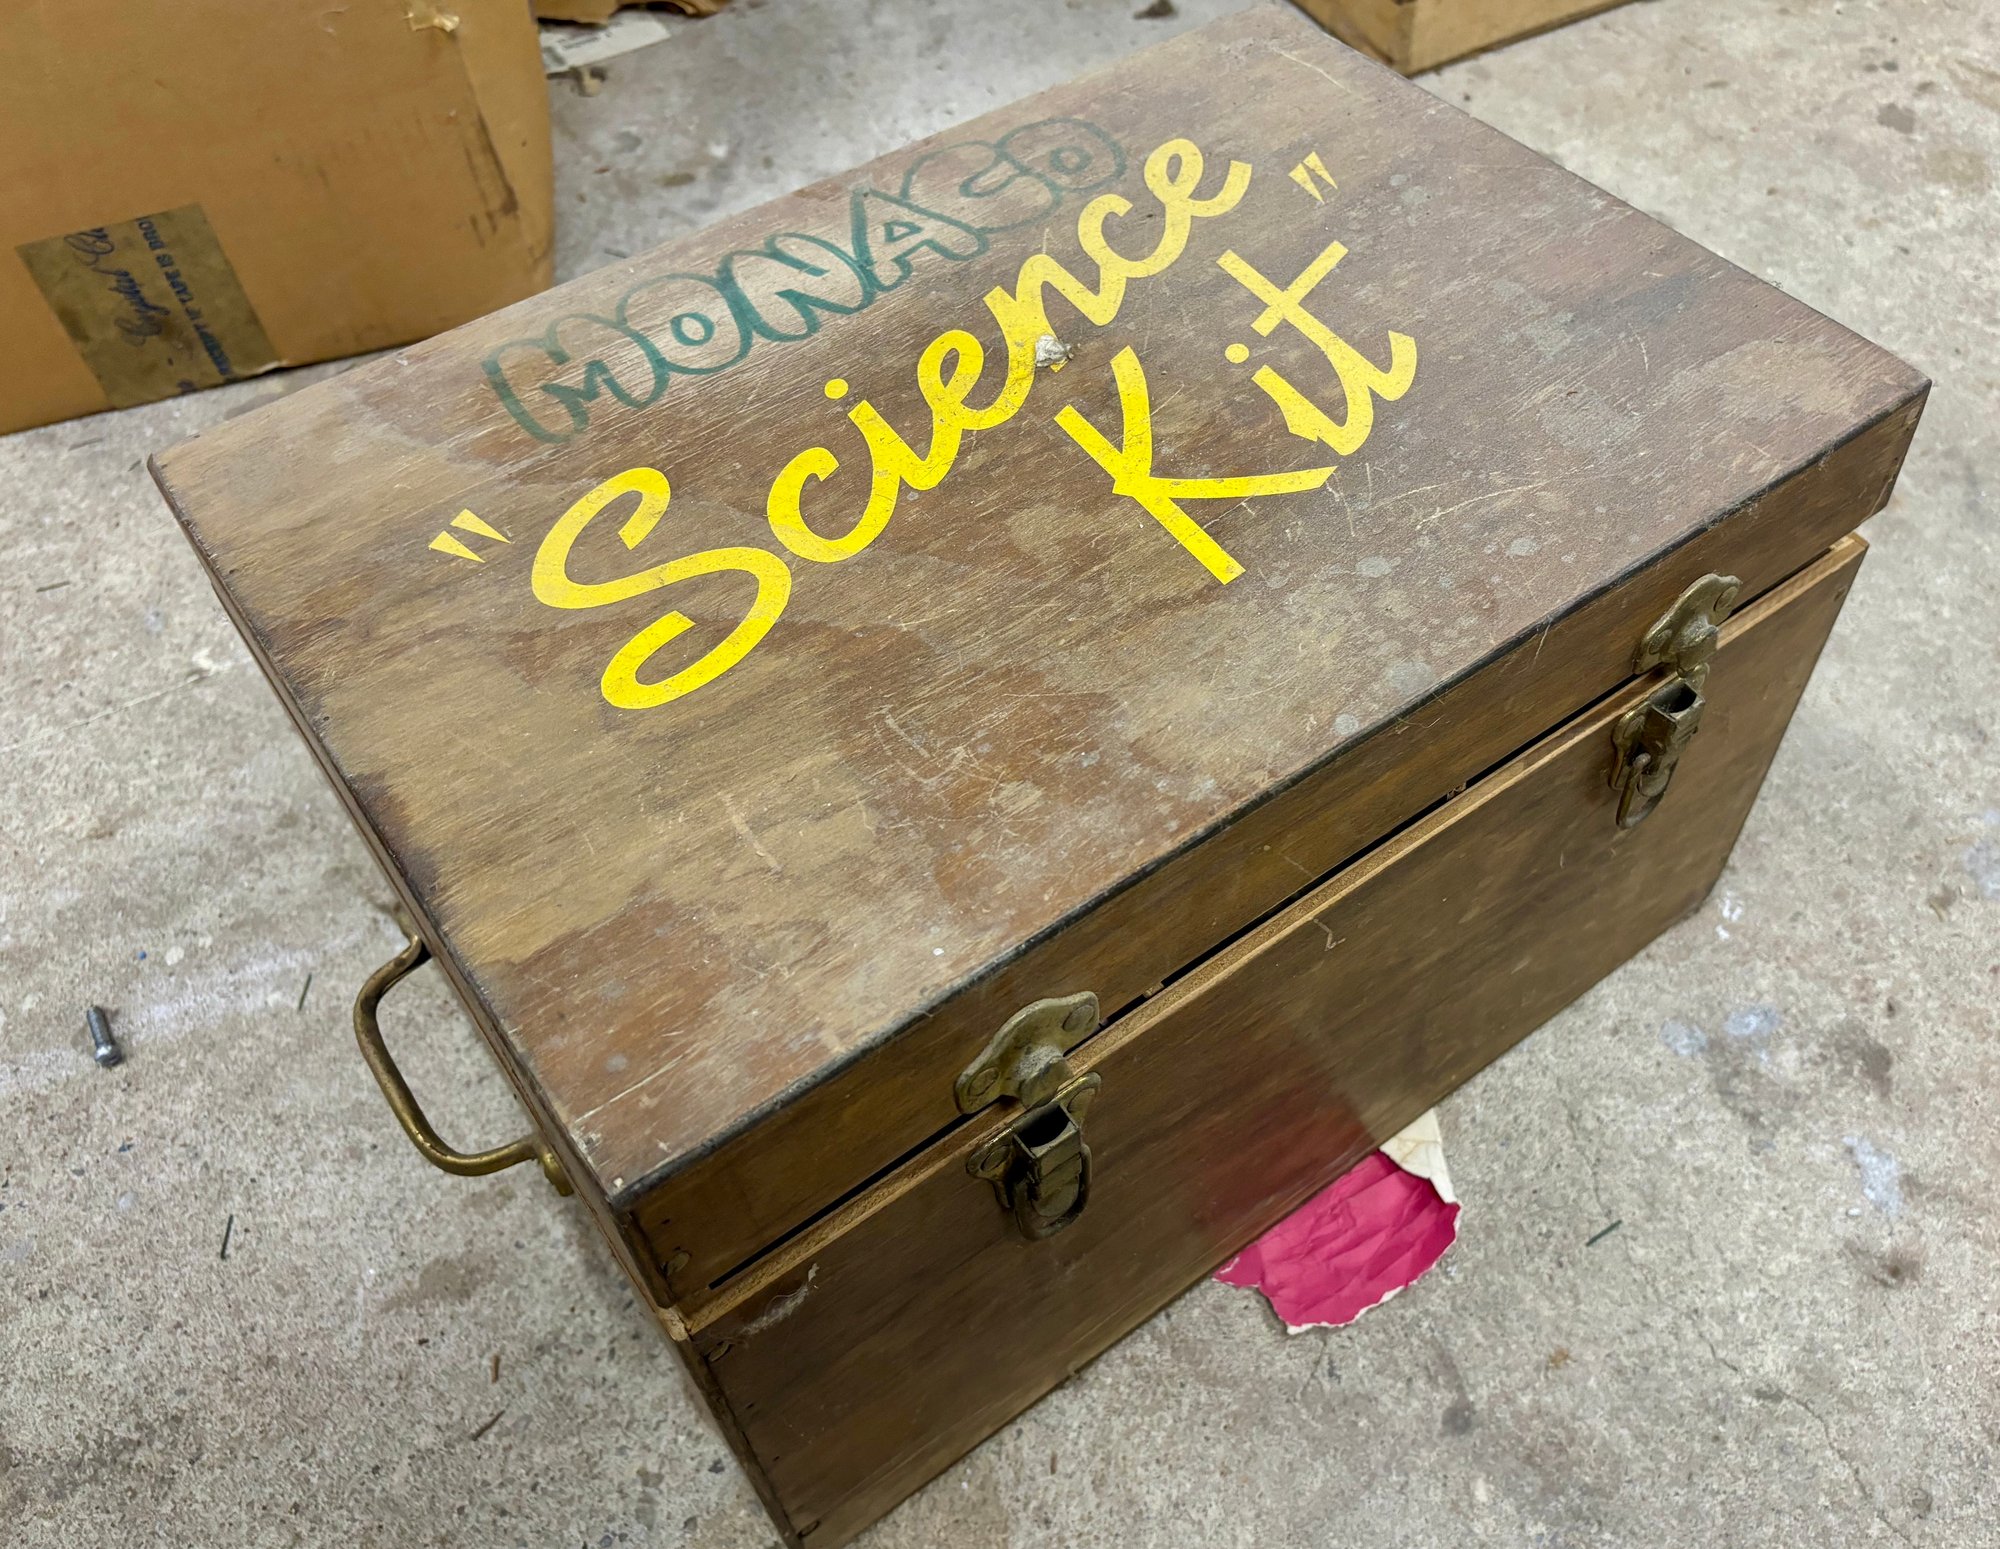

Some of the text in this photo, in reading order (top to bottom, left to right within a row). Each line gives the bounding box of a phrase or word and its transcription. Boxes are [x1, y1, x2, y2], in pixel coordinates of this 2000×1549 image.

[135, 217, 166, 251] BRO
[155, 253, 174, 268] IS
[164, 269, 194, 304] TAPE
[481, 116, 1127, 444] MONACO
